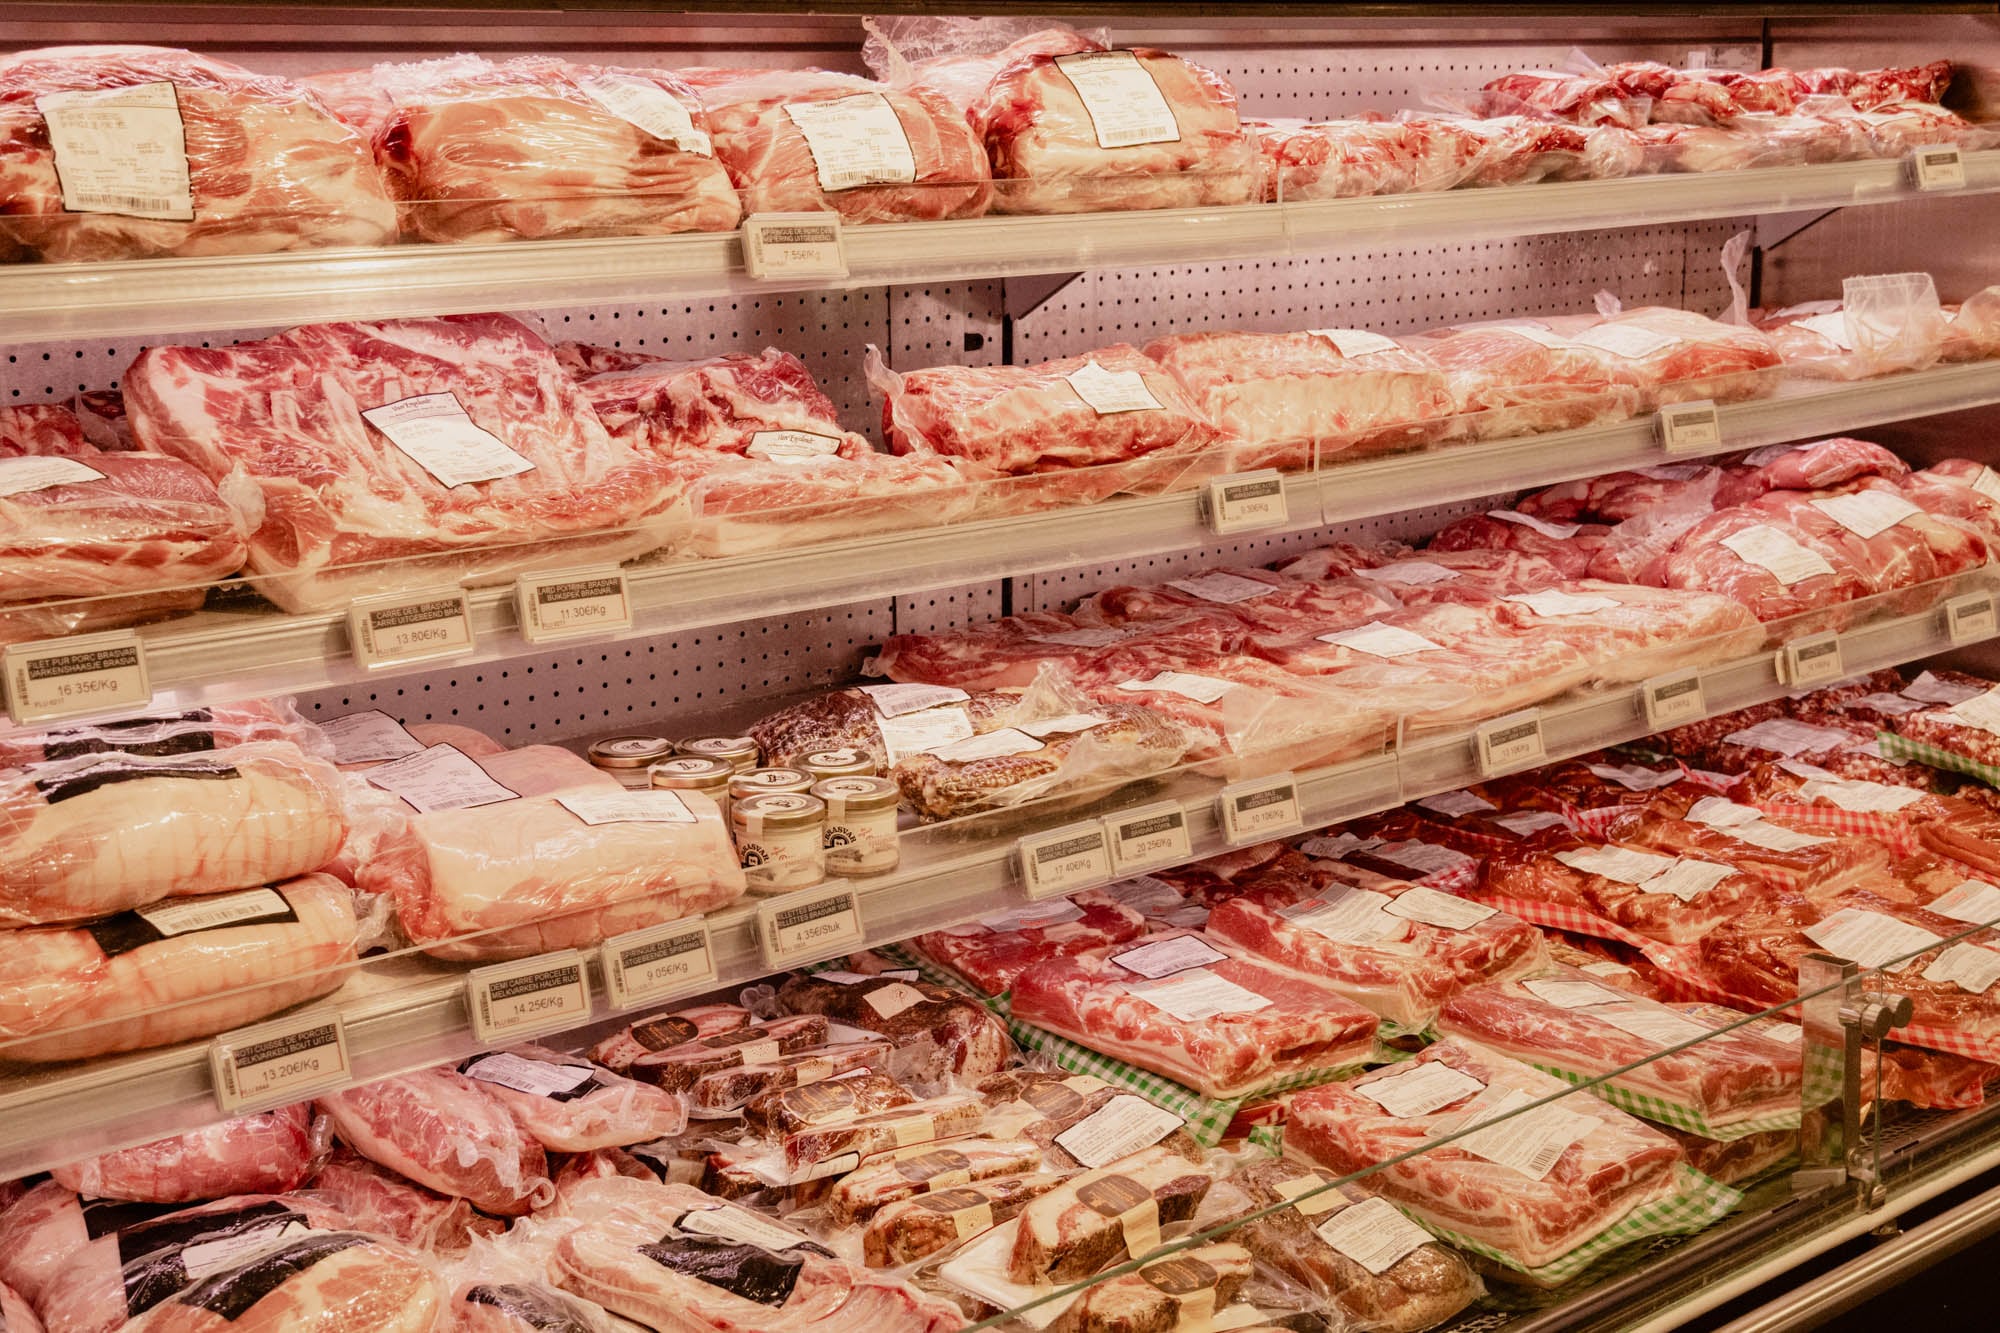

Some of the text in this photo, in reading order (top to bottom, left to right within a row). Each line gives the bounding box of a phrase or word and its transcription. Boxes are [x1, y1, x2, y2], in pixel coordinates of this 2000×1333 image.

[587, 577, 618, 589] BRASVAR
[547, 586, 612, 602] BUIKSPEK BRASVAR
[373, 618, 398, 629] CARRE
[398, 609, 444, 624] UITGEBEEND
[376, 609, 402, 620] CARRE
[28, 647, 137, 669] FILET PUR PORC BRASVAR
[30, 656, 137, 678] VARKENSHAASJE BRASVA
[824, 826, 857, 843] BRASVAR
[741, 843, 770, 863] BRASVAR
[490, 982, 509, 992] DEMI
[508, 975, 534, 988] CARRE
[534, 967, 571, 982] PORCELET
[491, 973, 578, 1000] MELKVARKEN HALVE RUG
[233, 1025, 336, 1059] ROTI CUISSE DE PORCELE
[235, 1032, 337, 1067] MELKVARKEN BOUT UITGE
